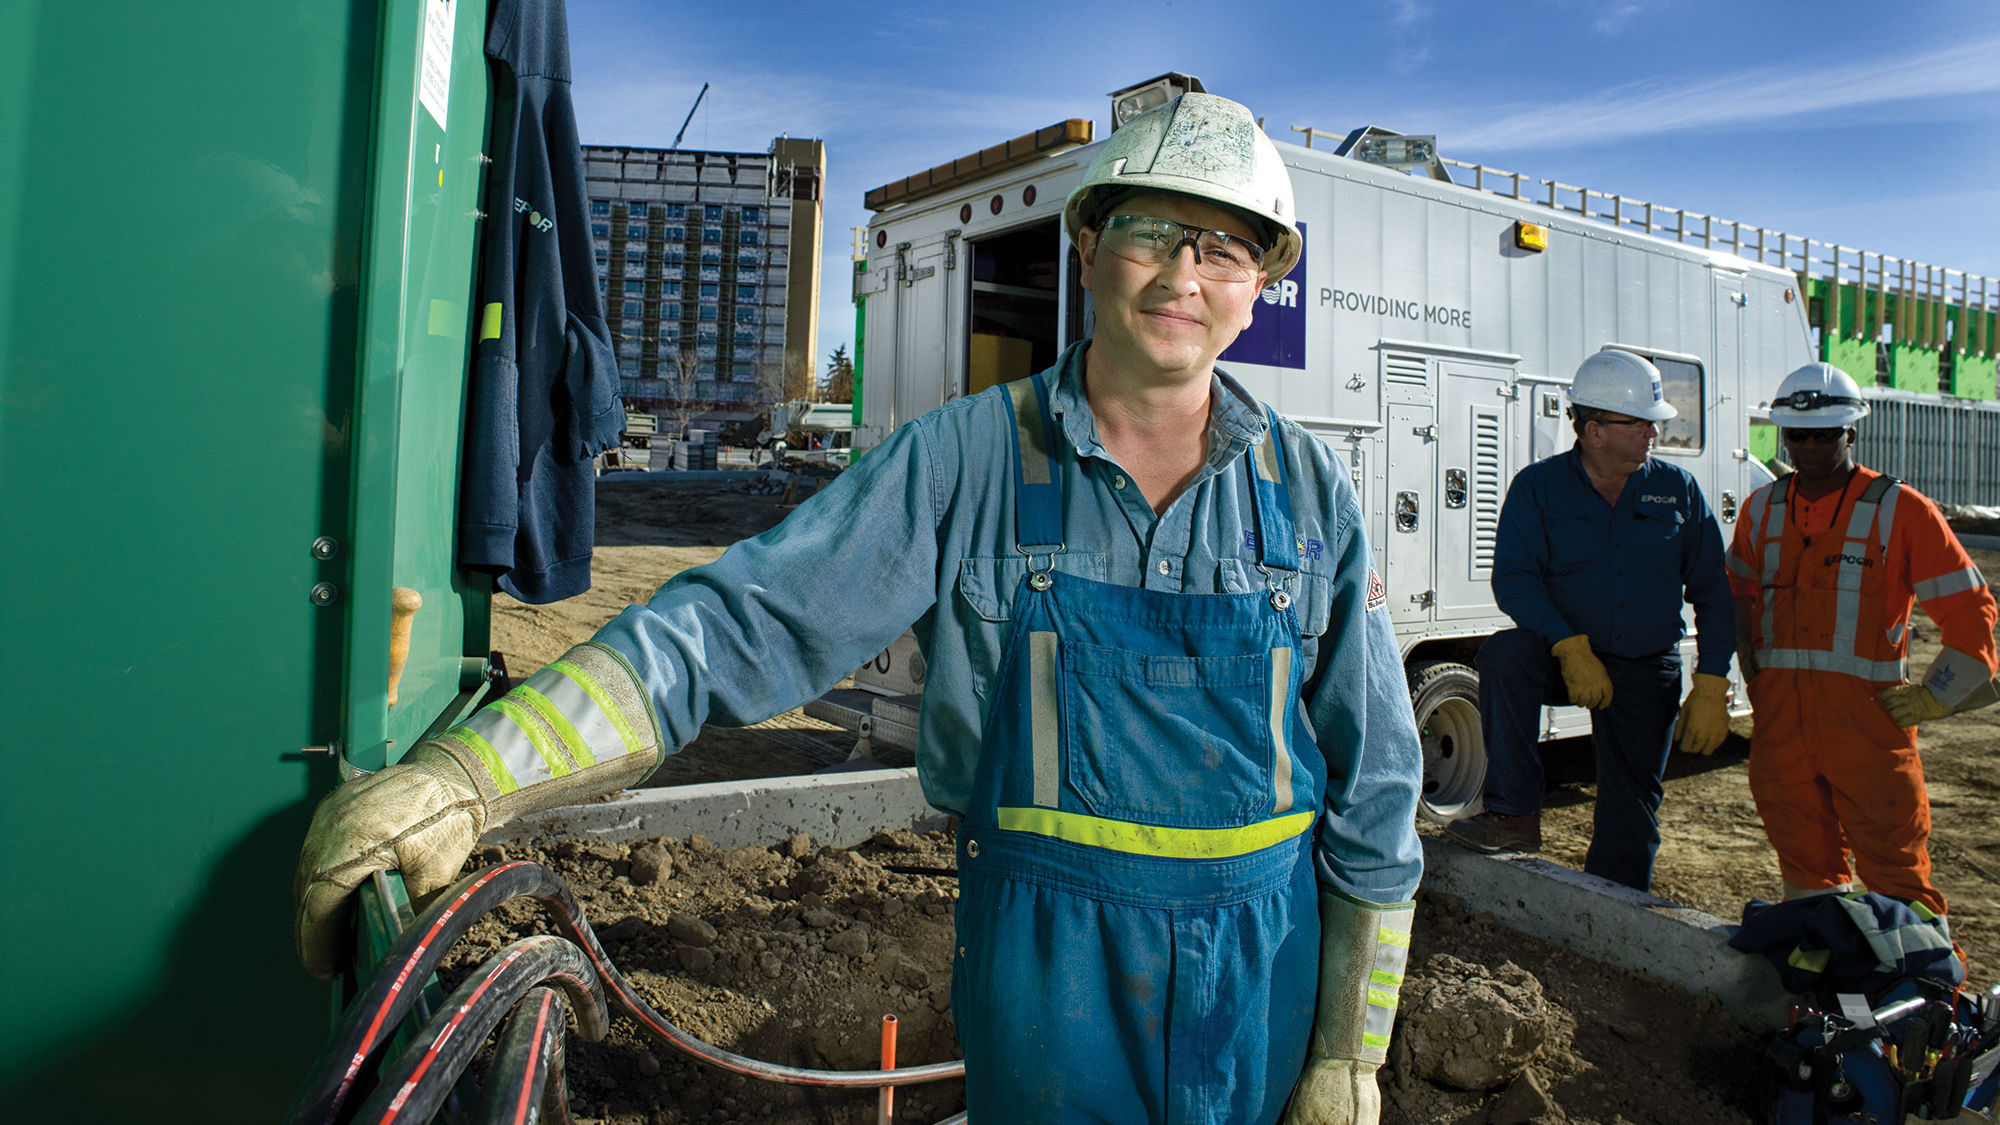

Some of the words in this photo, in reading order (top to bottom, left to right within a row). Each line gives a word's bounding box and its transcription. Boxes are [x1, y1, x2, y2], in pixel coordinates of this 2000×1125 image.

[1320, 287, 1419, 320] PROVIDING
[1424, 304, 1471, 328] MORE
[1641, 494, 1677, 504] EPCOR
